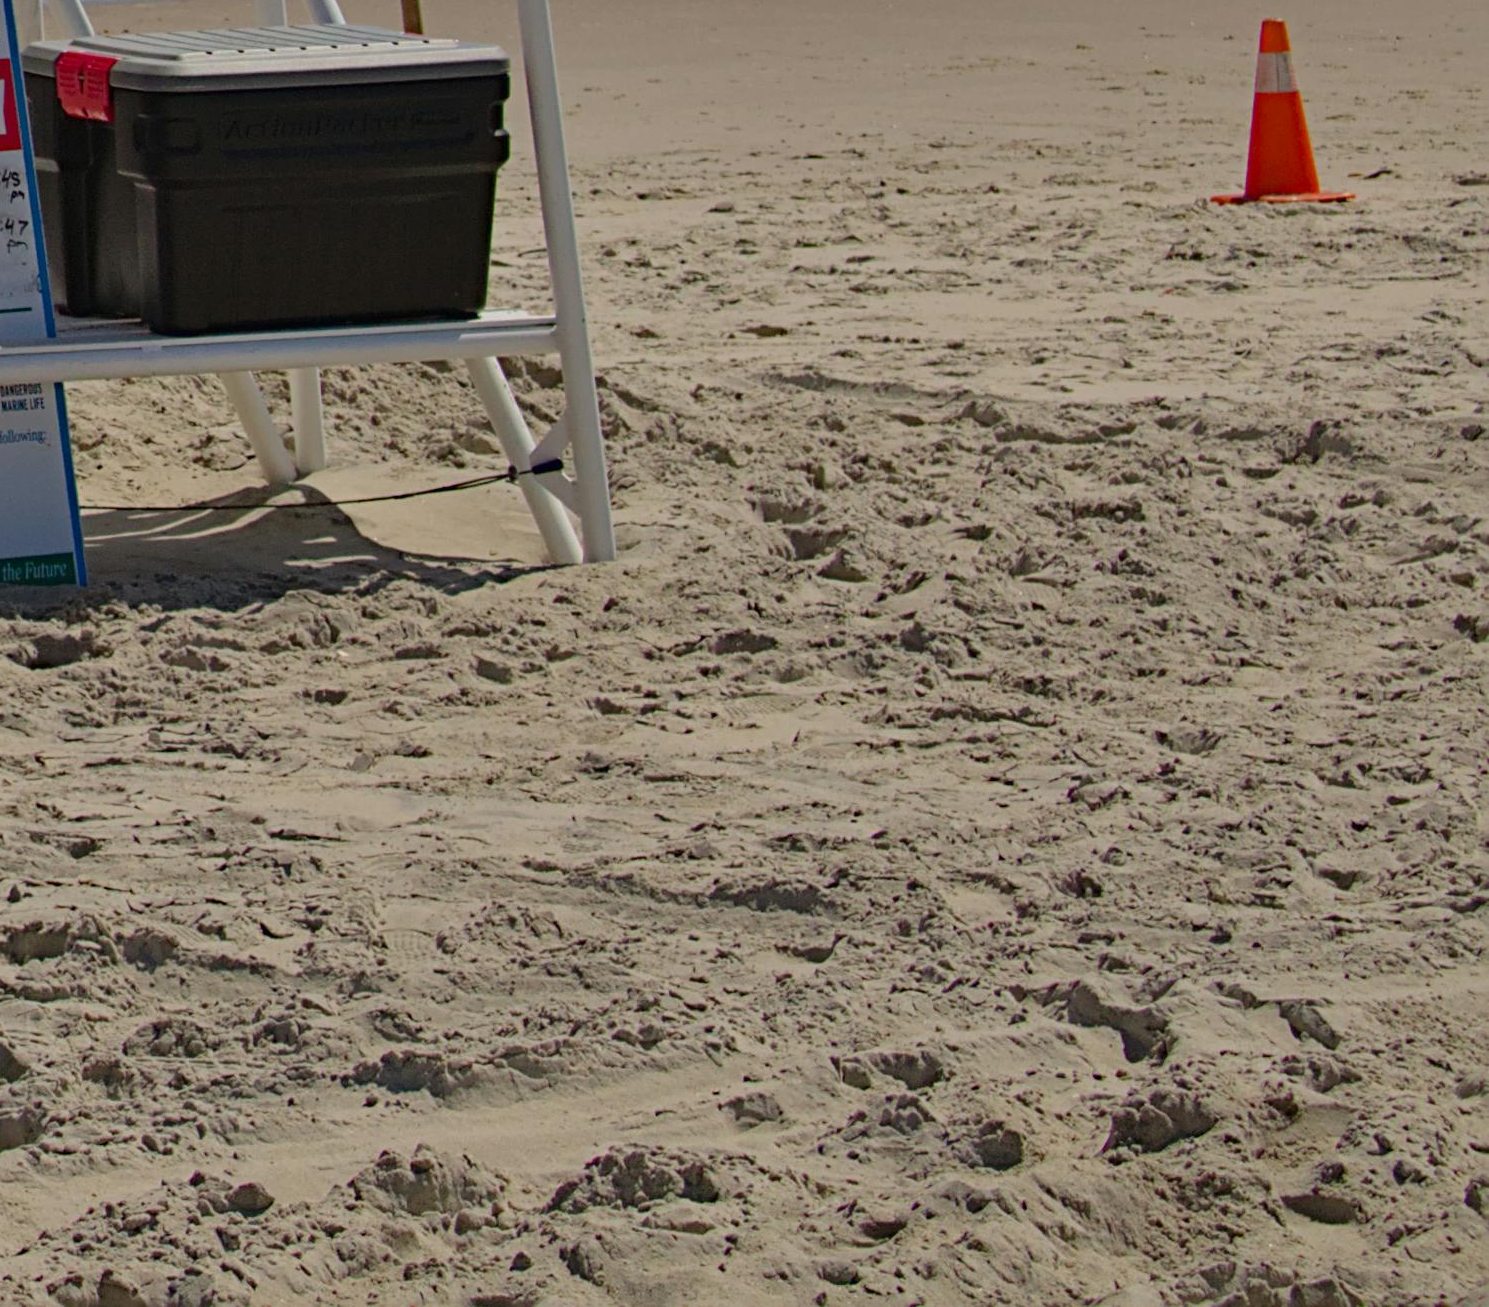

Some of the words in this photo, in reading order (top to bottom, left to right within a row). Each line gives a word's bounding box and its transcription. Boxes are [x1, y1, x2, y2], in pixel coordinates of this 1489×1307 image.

[0, 383, 42, 397] DANGEROUS
[1, 398, 28, 412] MARINE
[30, 397, 46, 410] LIFE
[2, 563, 22, 580] the
[25, 561, 67, 580] Future
